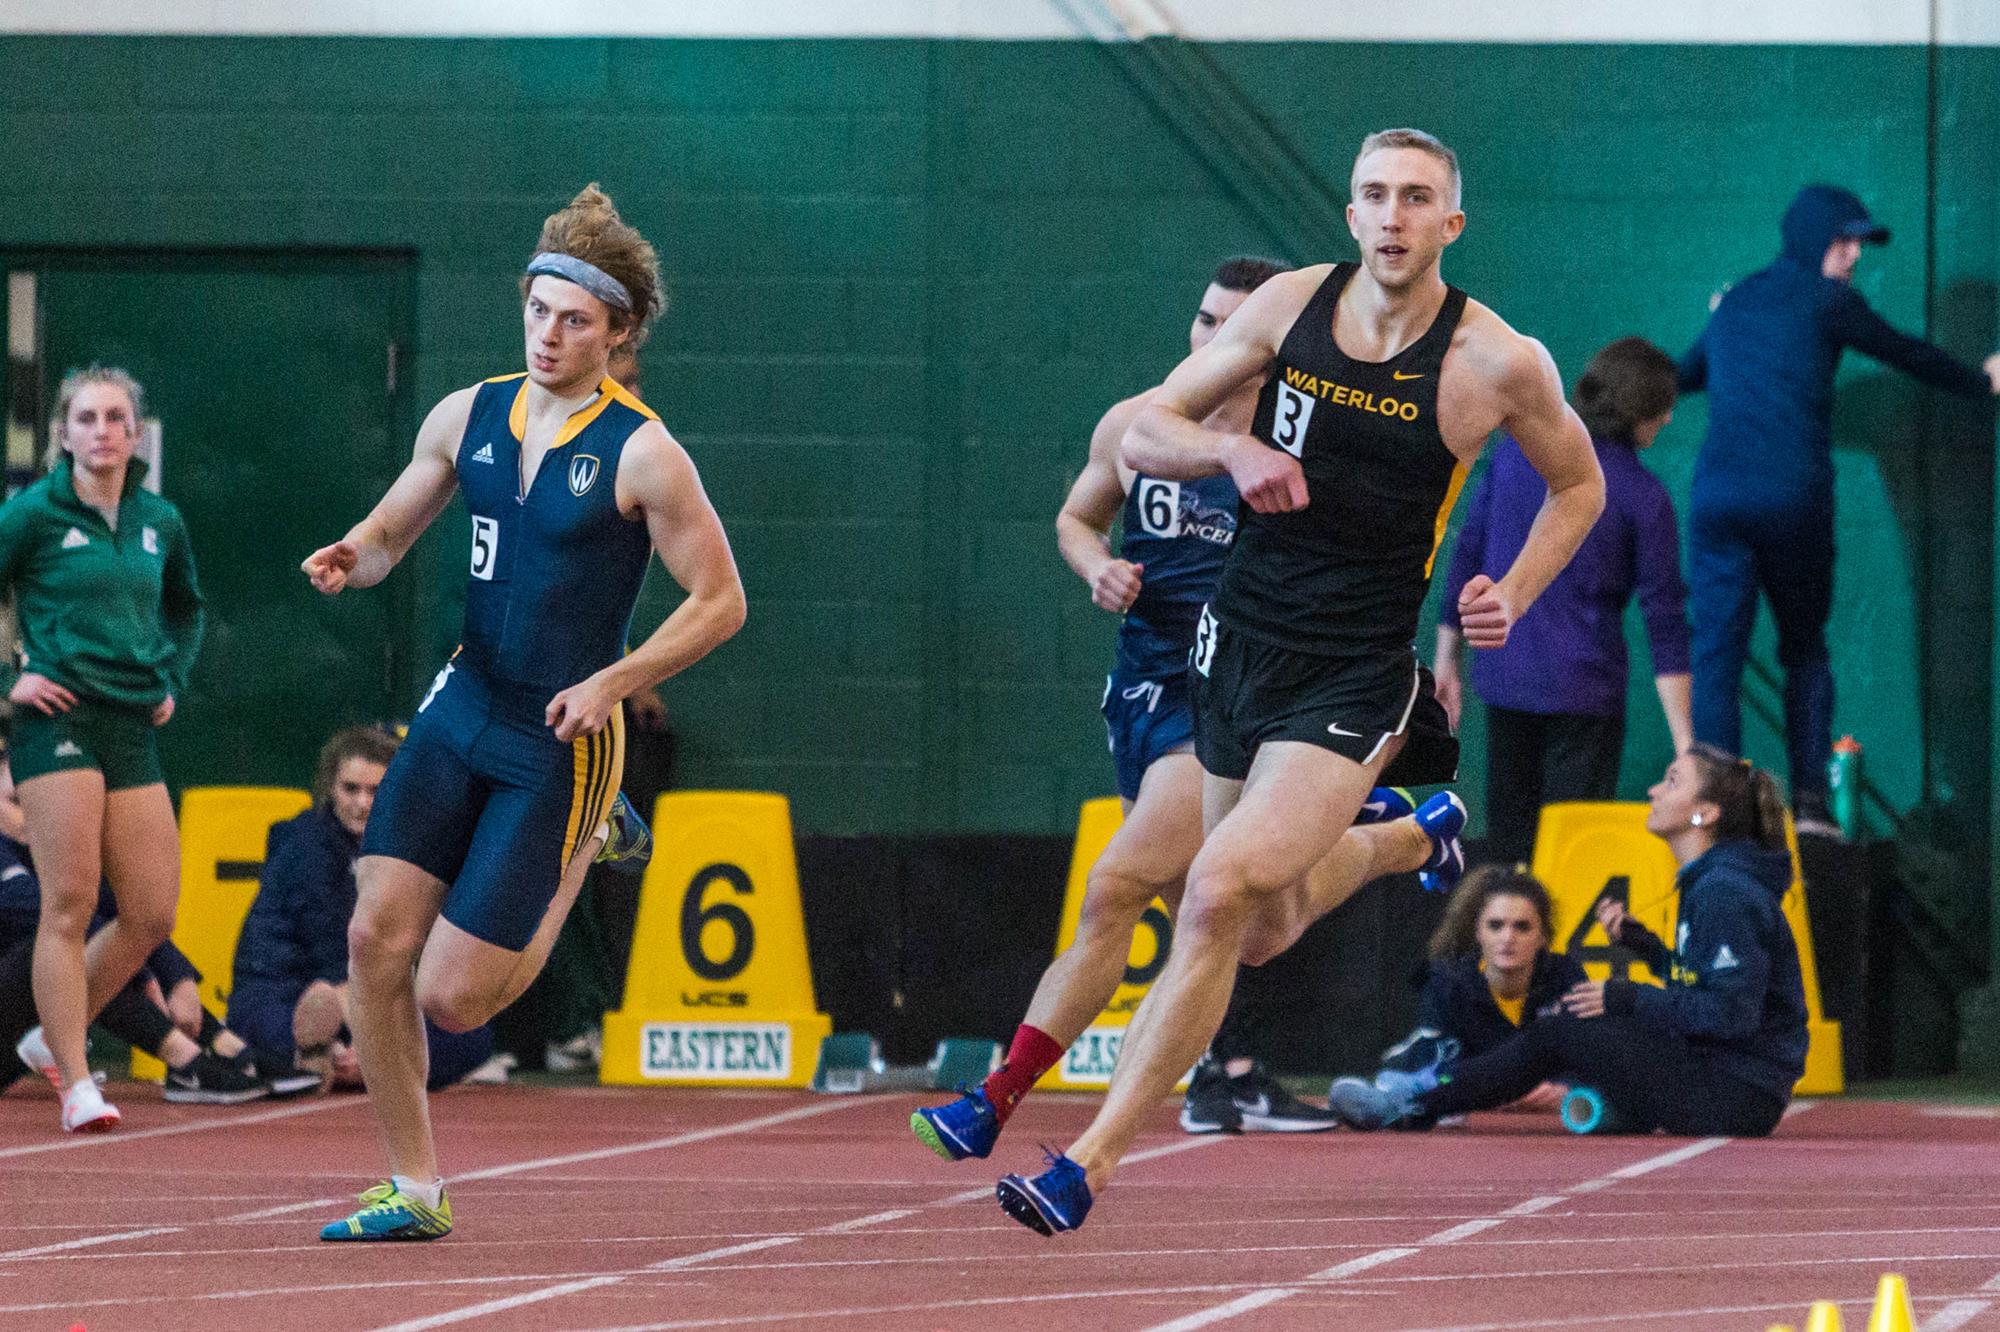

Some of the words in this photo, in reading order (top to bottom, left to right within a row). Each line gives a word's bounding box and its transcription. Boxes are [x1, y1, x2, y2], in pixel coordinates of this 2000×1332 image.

[1279, 391, 1303, 446] 3
[1286, 367, 1418, 421] WATERLOO
[472, 454, 494, 465] adidas
[1144, 484, 1172, 531] 6
[473, 520, 490, 574] 5
[1198, 613, 1212, 668] 3
[680, 862, 755, 980] 6
[1565, 876, 1648, 982] 4
[647, 1029, 786, 1071] EASTERN
